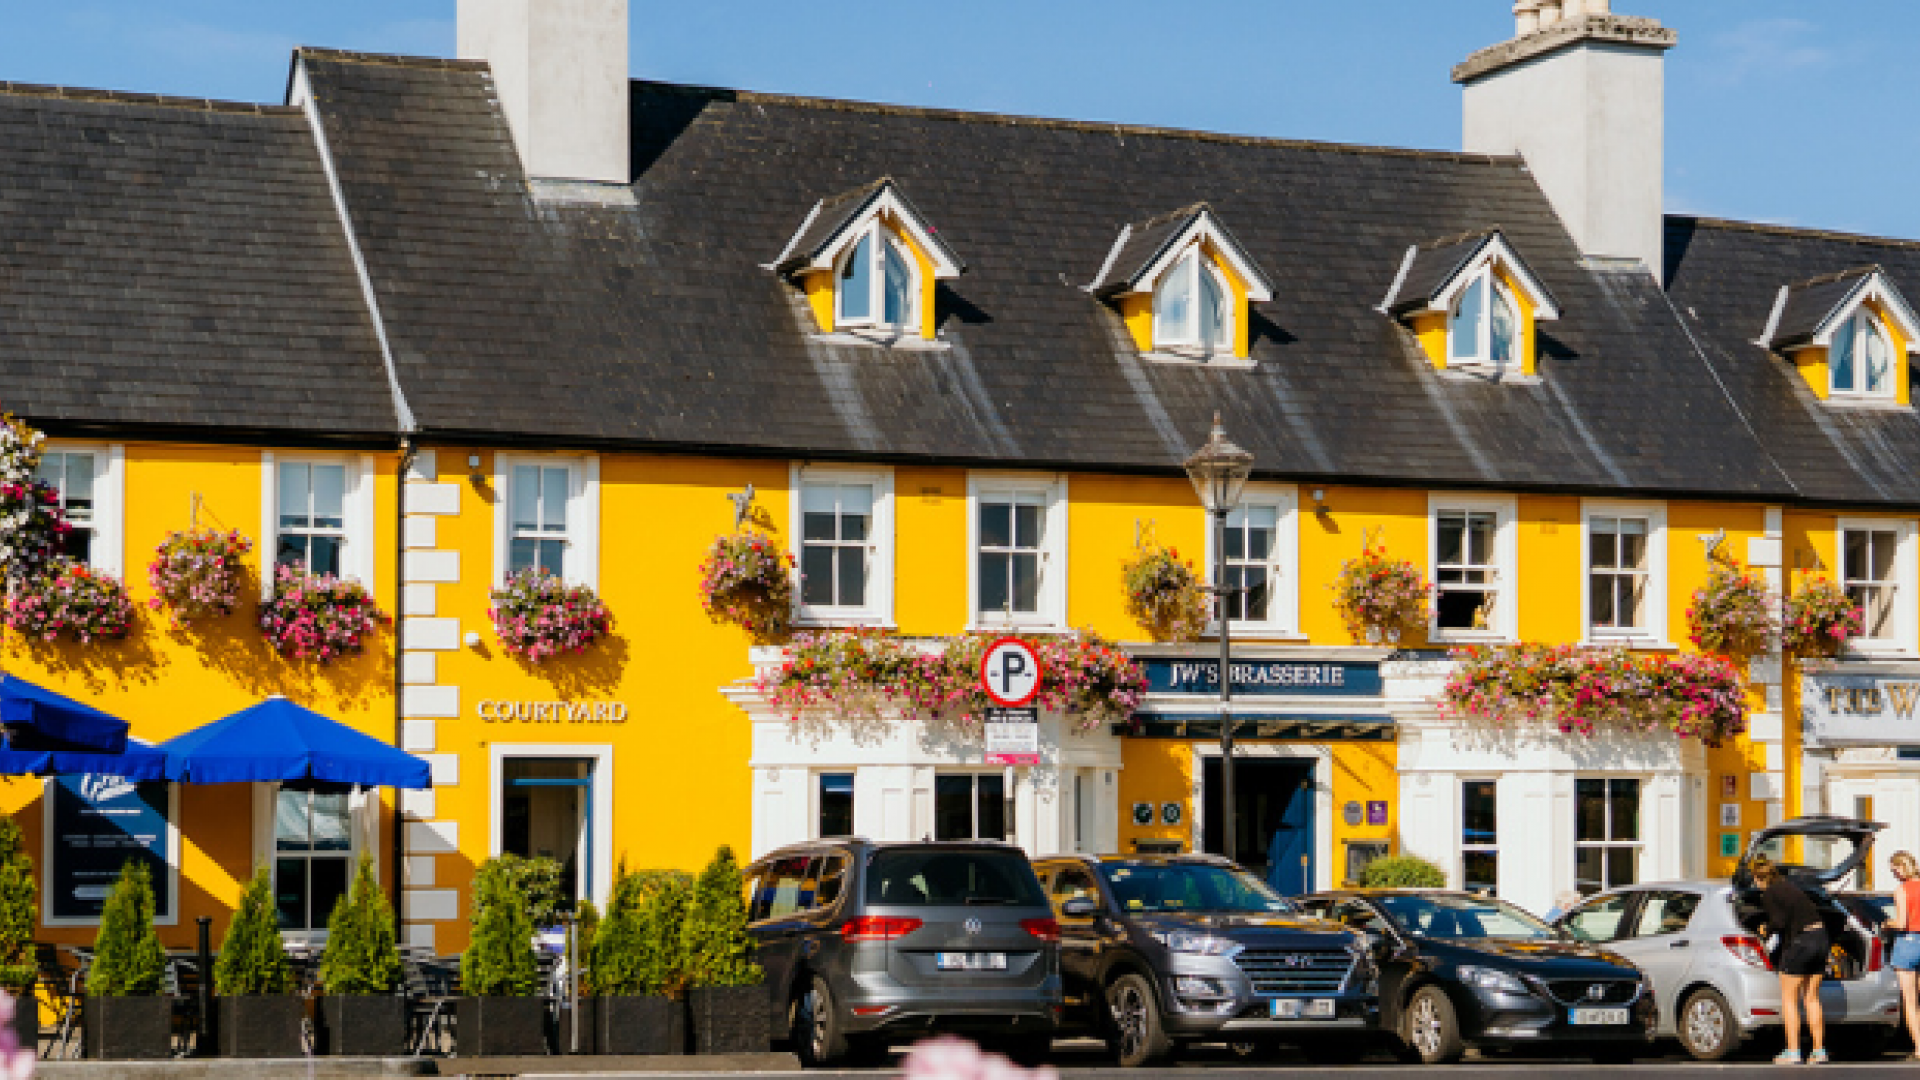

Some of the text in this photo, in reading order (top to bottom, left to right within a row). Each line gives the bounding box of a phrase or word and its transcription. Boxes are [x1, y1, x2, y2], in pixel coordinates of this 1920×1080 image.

[1002, 651, 1026, 693] P
[1169, 663, 1345, 687] JW'S BRASSERIE
[476, 699, 628, 723] COURTYARD
[1824, 685, 1882, 714] THE
